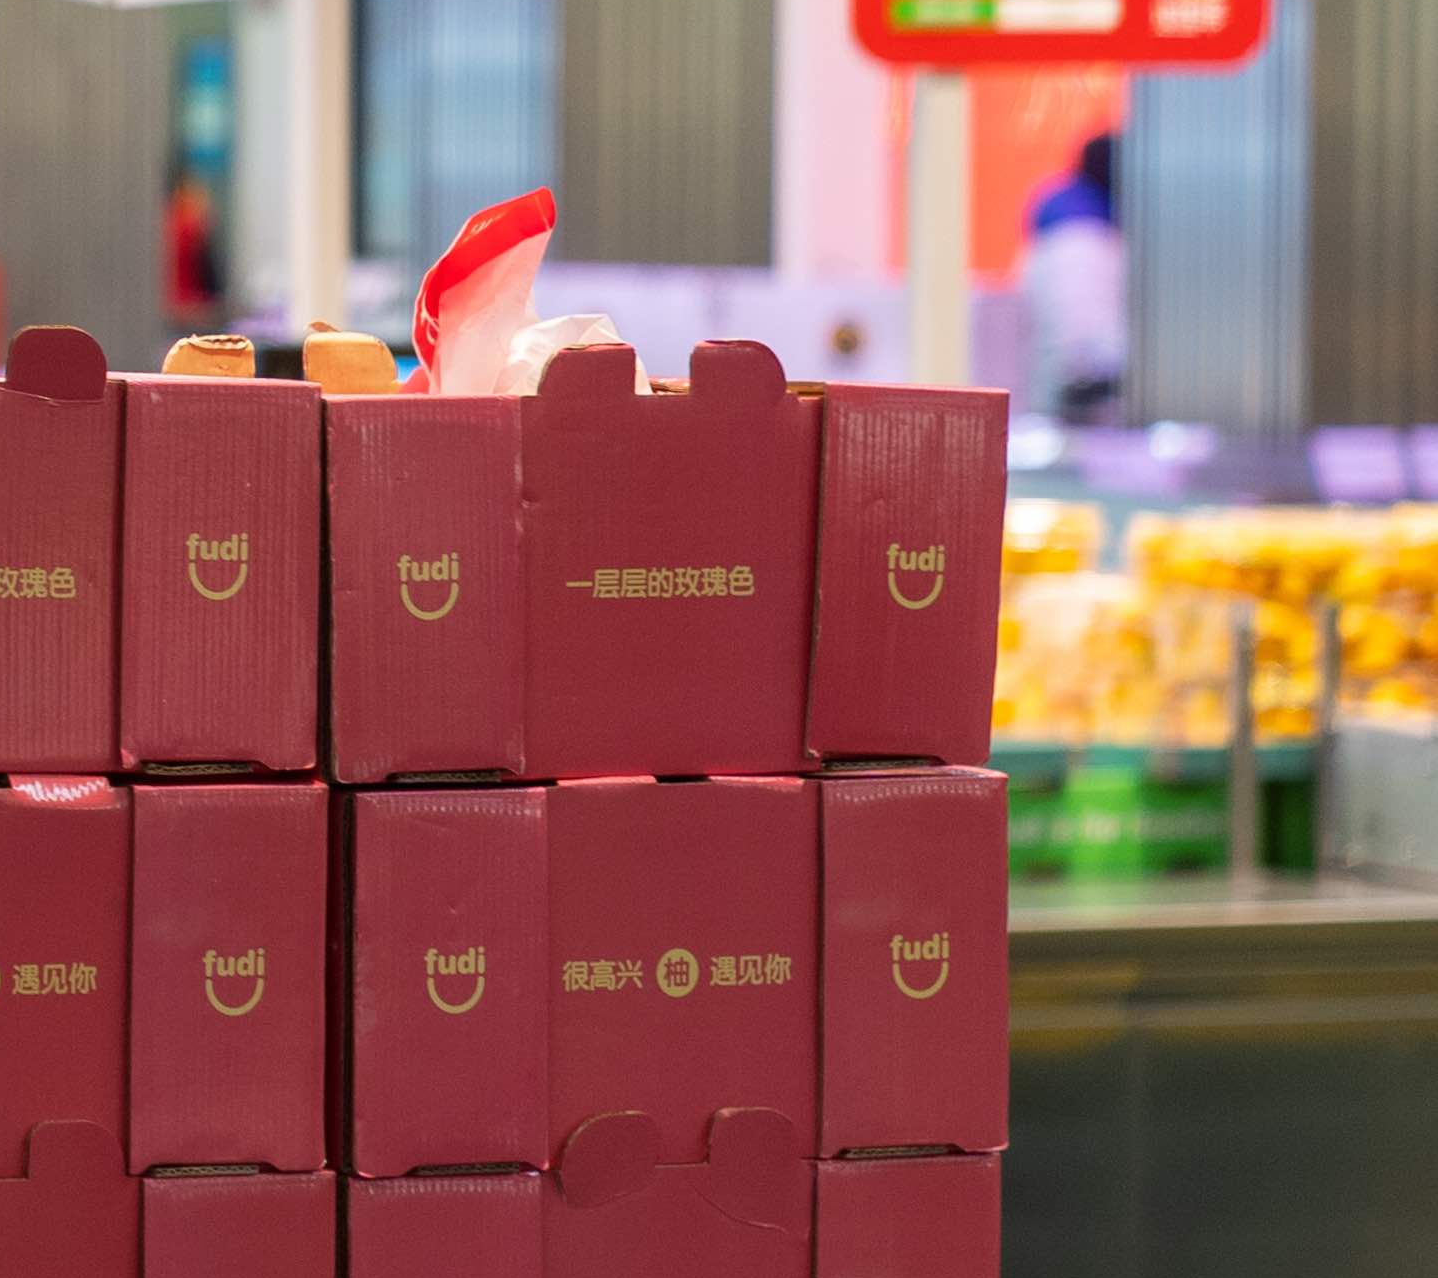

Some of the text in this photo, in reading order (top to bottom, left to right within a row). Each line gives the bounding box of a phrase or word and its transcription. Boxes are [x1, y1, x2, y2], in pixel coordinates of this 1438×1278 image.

[185, 533, 249, 562] fudi
[886, 544, 945, 572] fudi
[398, 552, 459, 582] fudi
[566, 567, 755, 600] 一层层的玫瑰色
[424, 947, 485, 977] fudi
[889, 933, 949, 961] fudi
[203, 948, 266, 978] fudi
[563, 960, 644, 992] 很高兴
[709, 954, 792, 987] 遇见你
[11, 963, 98, 996] 遇见你
